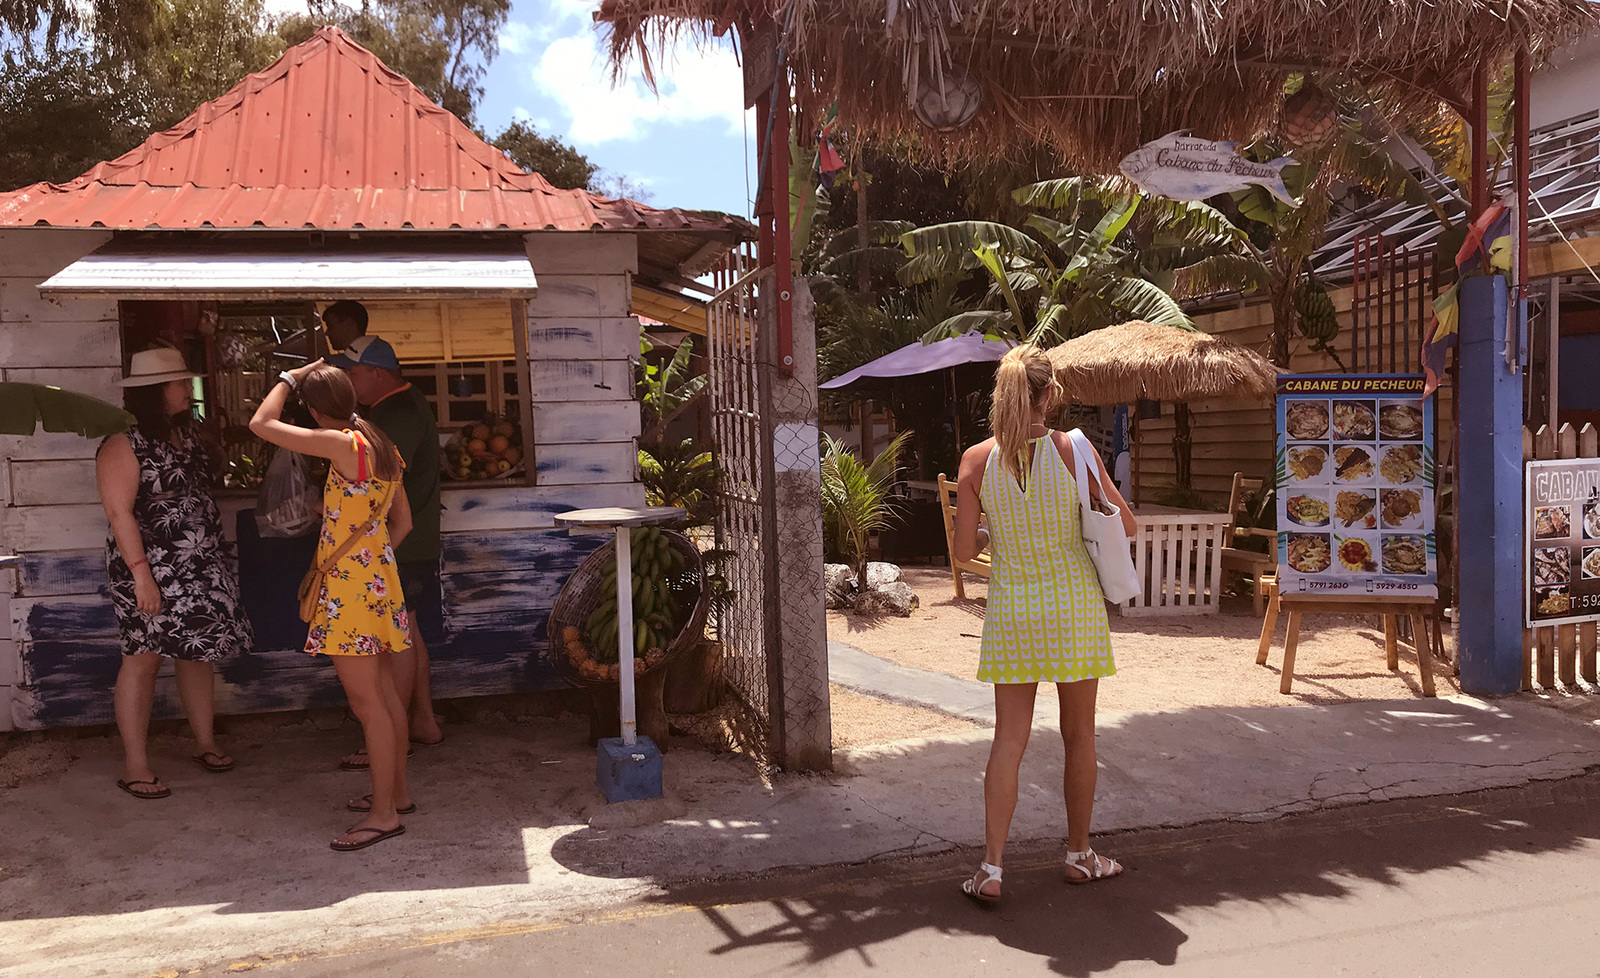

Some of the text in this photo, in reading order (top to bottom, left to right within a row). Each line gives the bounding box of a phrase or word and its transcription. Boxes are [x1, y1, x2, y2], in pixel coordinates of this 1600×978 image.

[1157, 148, 1204, 172] Cabane
[1206, 159, 1223, 173] du
[1285, 380, 1424, 391] CABANE DU PECHEUR
[1328, 582, 1349, 590] 2630
[1376, 582, 1418, 591] 5929 4550
